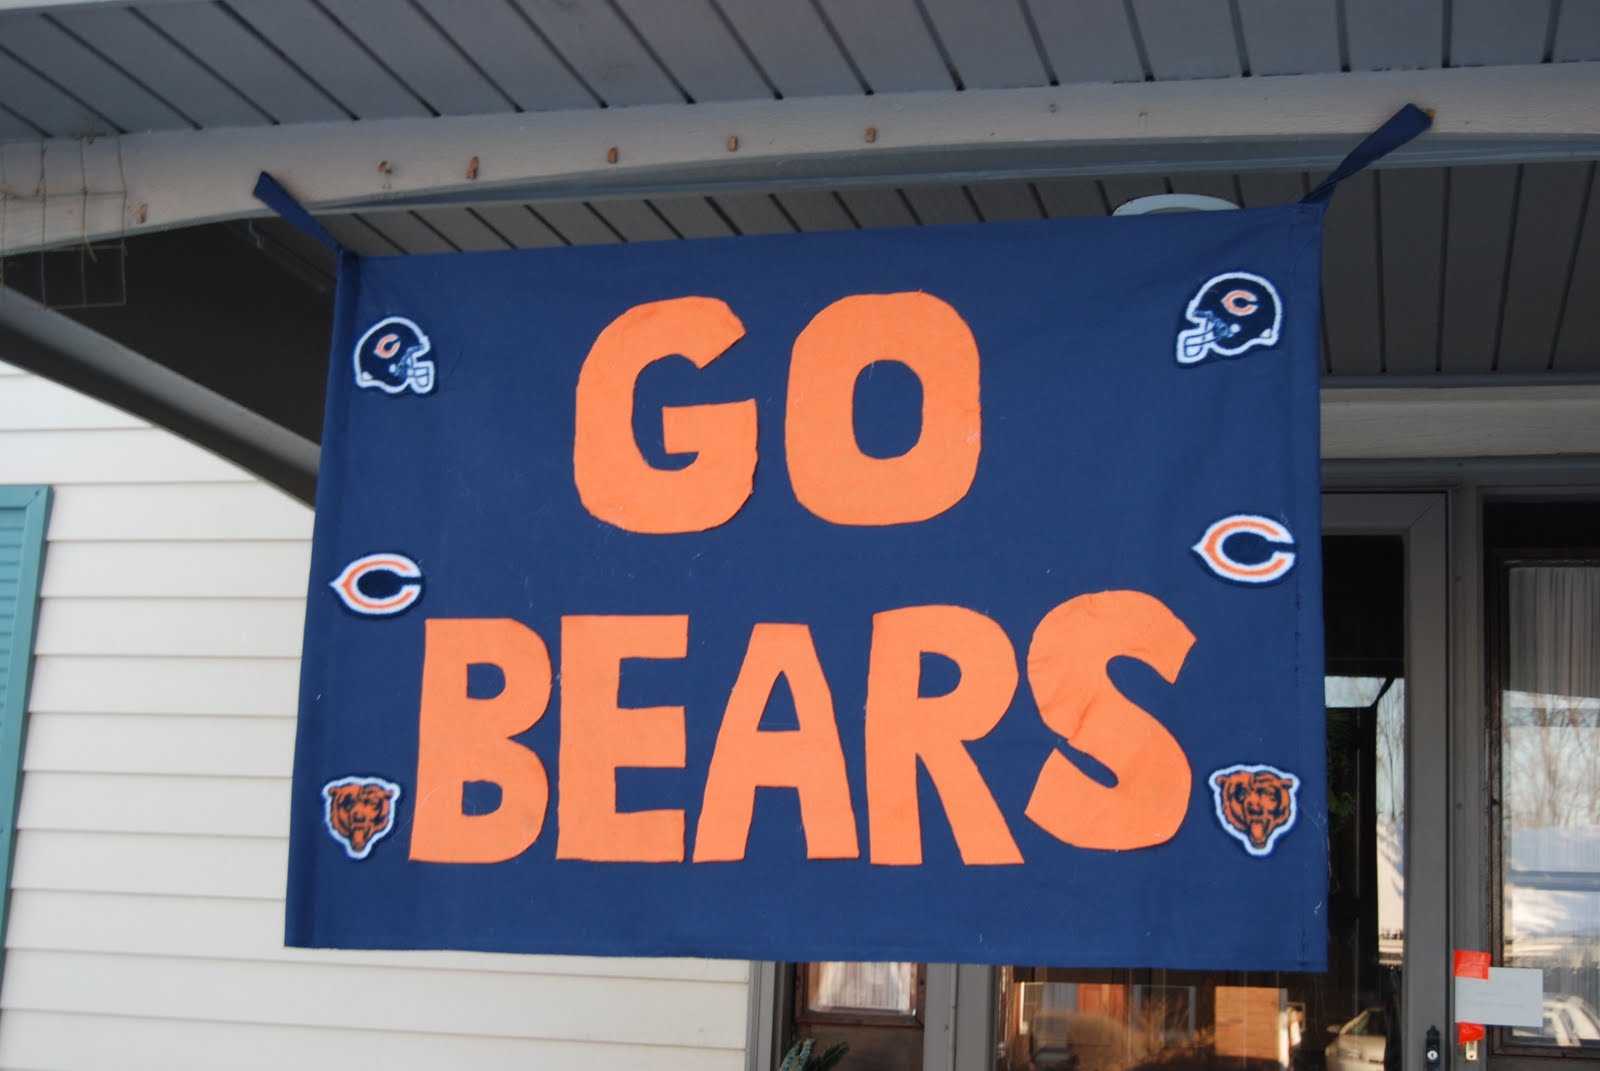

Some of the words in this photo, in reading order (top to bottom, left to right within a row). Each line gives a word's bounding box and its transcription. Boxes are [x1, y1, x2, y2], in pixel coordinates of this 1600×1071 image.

[1221, 290, 1259, 316] C
[374, 333, 401, 359] C
[574, 291, 982, 535] GO
[1191, 514, 1296, 583] C
[328, 552, 422, 615] C
[409, 590, 1197, 866] BEARS
